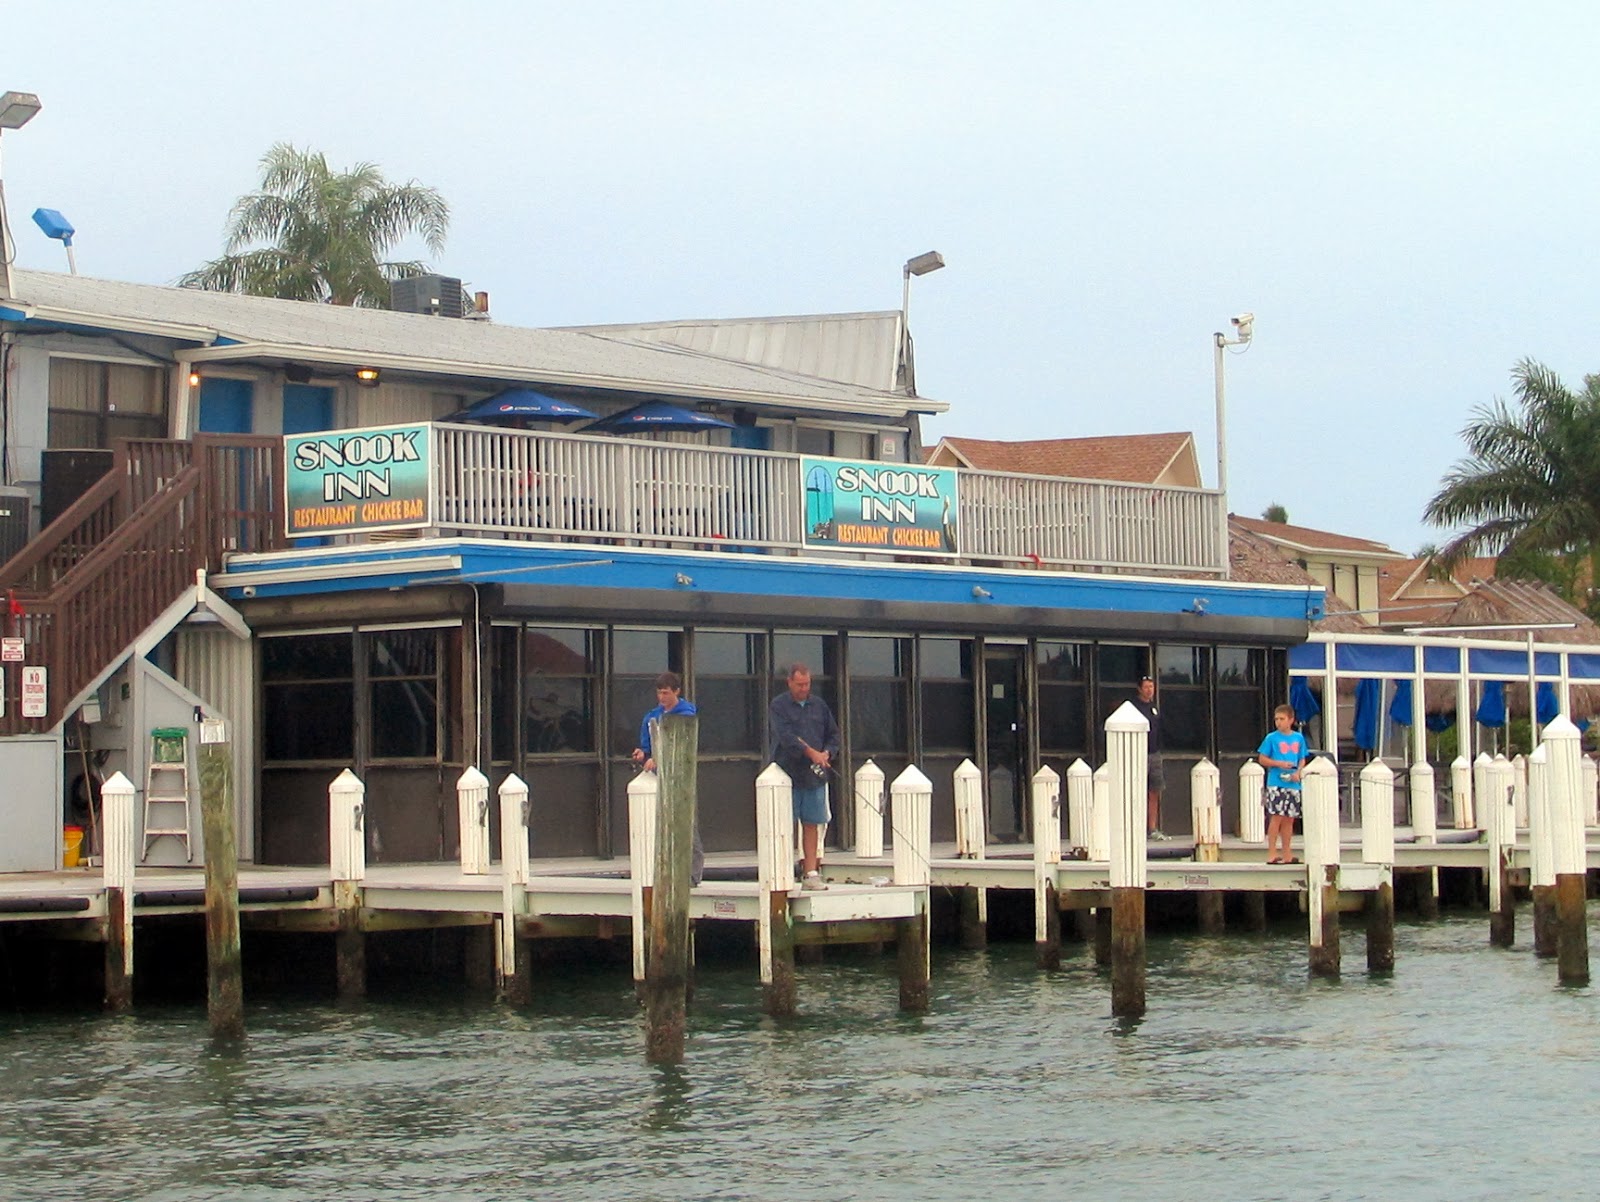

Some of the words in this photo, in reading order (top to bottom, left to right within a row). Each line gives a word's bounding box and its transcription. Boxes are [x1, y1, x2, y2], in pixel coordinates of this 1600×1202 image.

[294, 430, 421, 471] SNOOK
[323, 467, 391, 502] INN
[835, 466, 939, 498] SNOOK
[294, 505, 357, 527] RESTAURANT
[361, 501, 402, 522] CHICKEE
[403, 499, 424, 517] BAR
[860, 495, 916, 524] INN
[837, 524, 889, 545] RESTAURANT
[892, 527, 923, 546] CHICKEE
[923, 529, 941, 547] BAR
